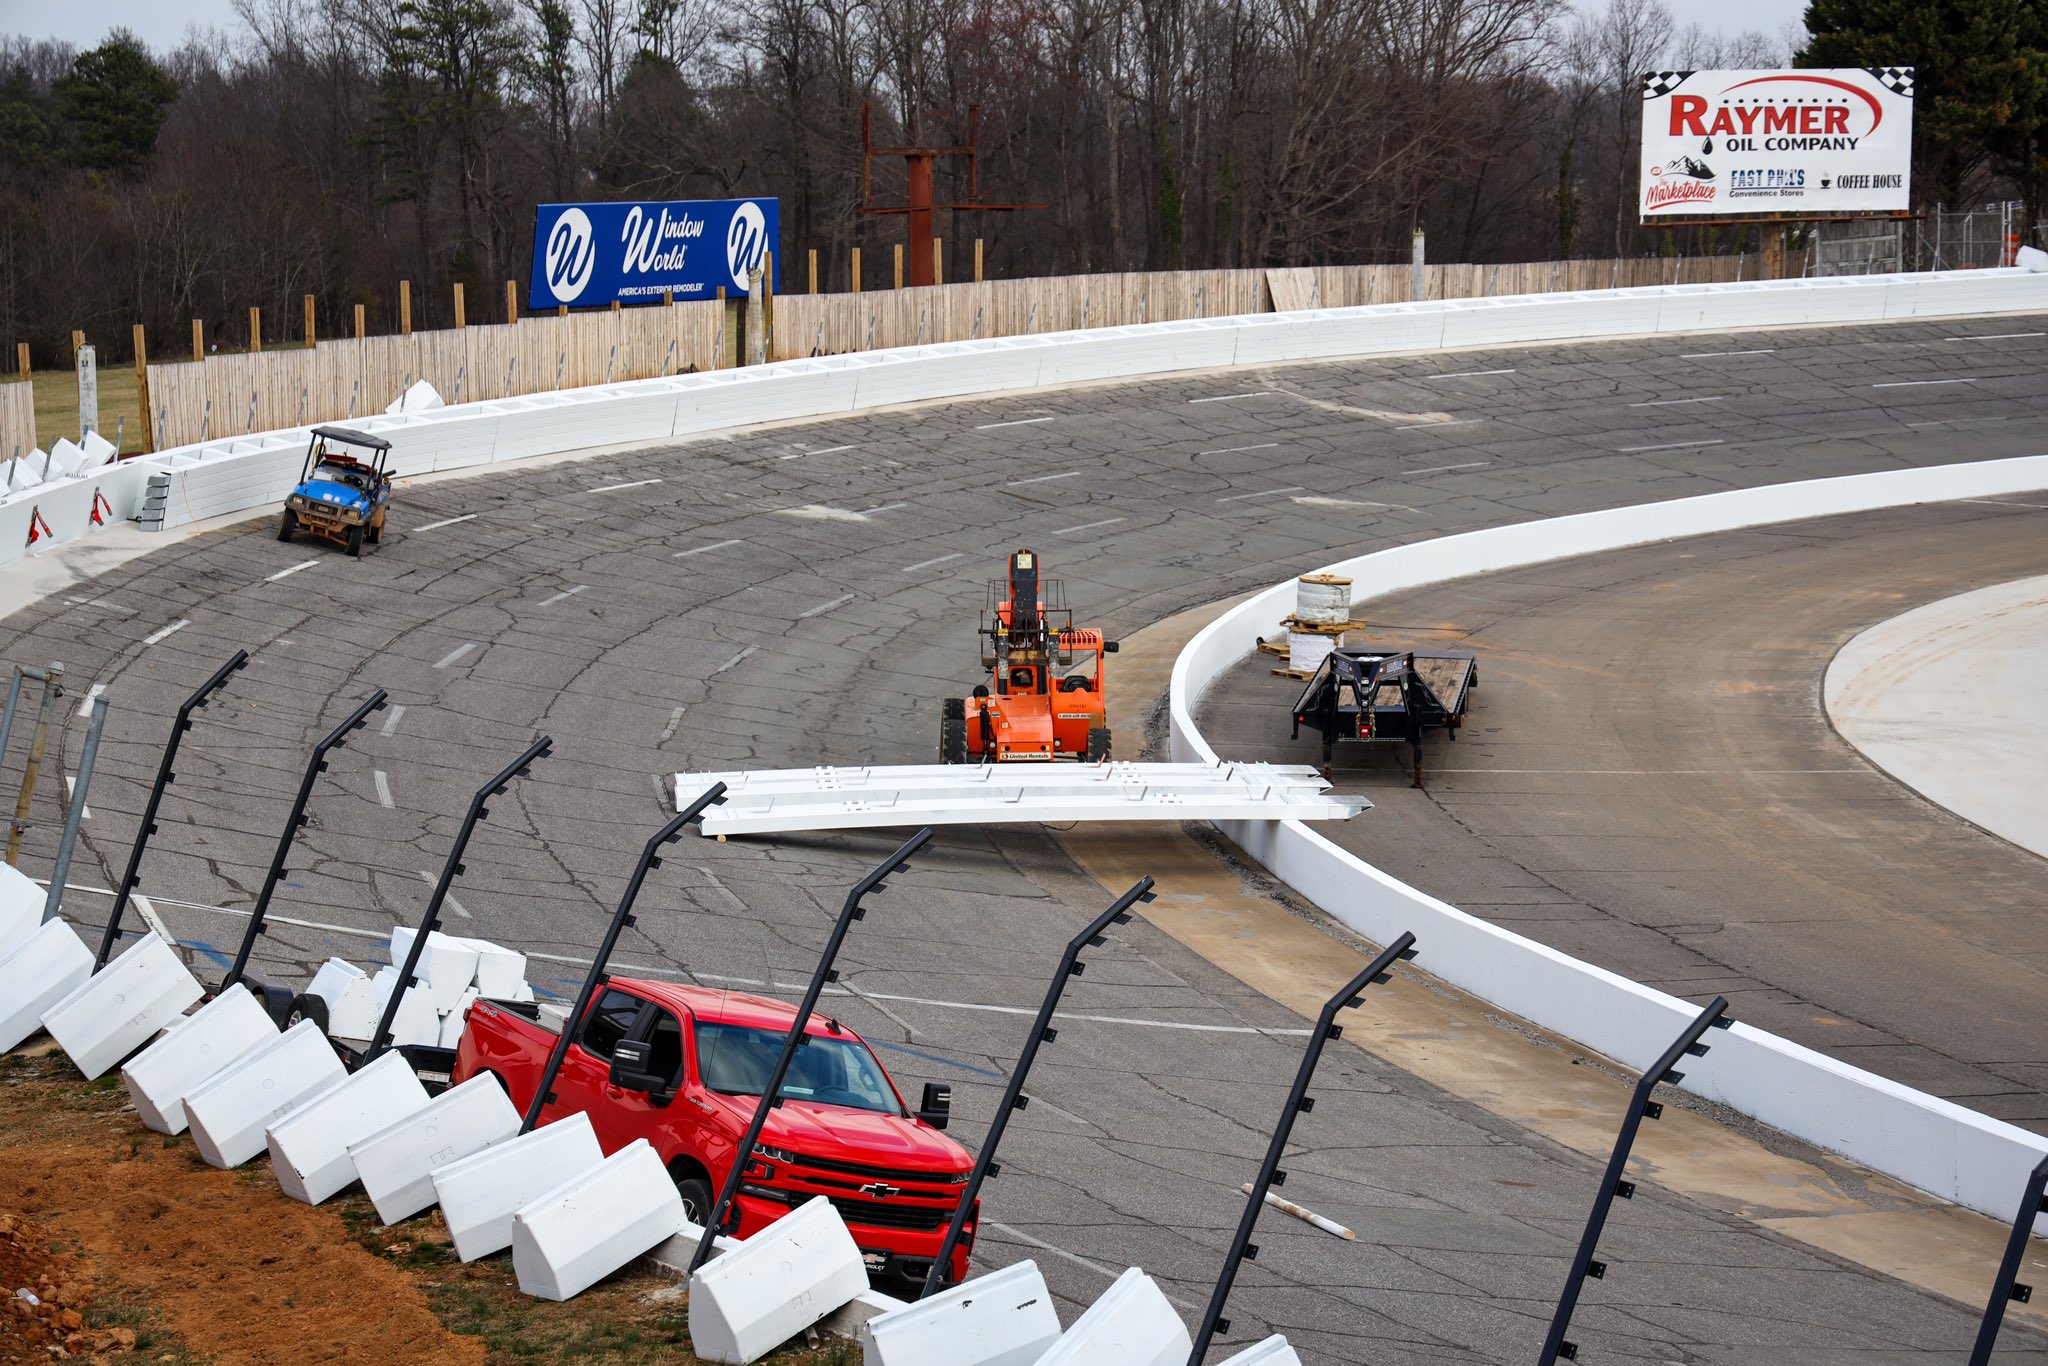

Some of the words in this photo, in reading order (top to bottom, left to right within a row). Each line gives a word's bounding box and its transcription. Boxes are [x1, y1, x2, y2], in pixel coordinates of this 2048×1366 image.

[1669, 95, 1850, 136] RAYMER
[1726, 138, 1758, 152] OIL
[1765, 137, 1860, 151] COMPANY
[1731, 169, 1763, 187] FAST
[1837, 174, 1870, 189] COFFEE
[1872, 174, 1903, 188] HOUSE
[1645, 180, 1716, 206] Marketplace
[618, 286, 646, 296] AMERICA'S
[673, 283, 704, 293] REMODELER
